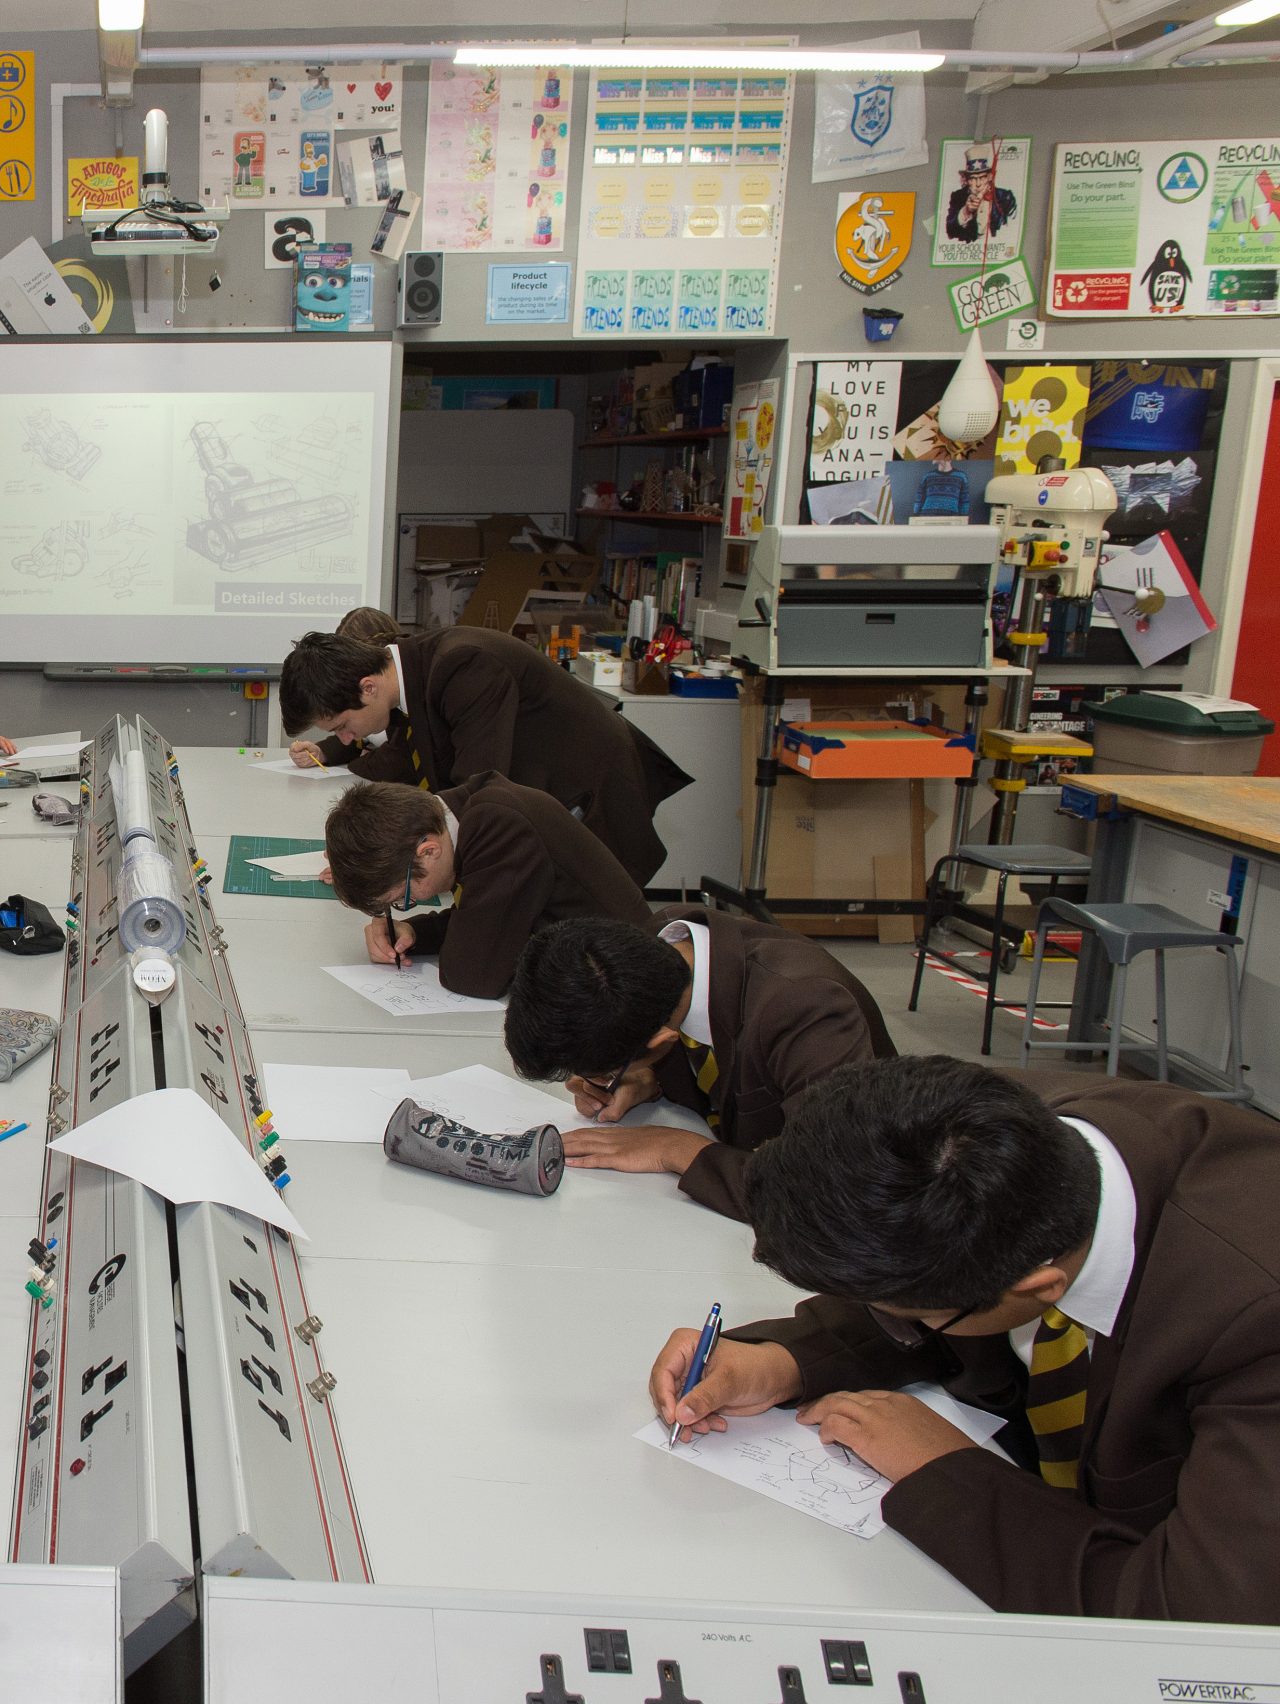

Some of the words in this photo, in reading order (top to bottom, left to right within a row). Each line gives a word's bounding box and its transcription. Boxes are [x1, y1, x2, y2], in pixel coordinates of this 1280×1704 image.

[371, 104, 395, 114] you!
[1064, 150, 1140, 168] RECYCLING!
[82, 162, 127, 180] AMIGOS
[938, 244, 956, 253] YOUR
[956, 244, 982, 253] SCHOOL
[511, 282, 548, 290] lifecycle
[842, 272, 852, 283] NIL
[852, 279, 867, 292] SINE
[871, 272, 899, 292] LABORE
[1158, 274, 1181, 285] SAVE
[958, 280, 984, 304] GO
[961, 284, 1022, 324] GREEN
[847, 362, 873, 372] MY
[831, 381, 886, 395] LOVE
[836, 404, 877, 417] FOR
[1007, 398, 1050, 418] we
[870, 426, 889, 440] IS
[222, 592, 284, 604] Detailed
[288, 592, 356, 606] Sketches
[1159, 1682, 1253, 1700] POWERTRAC
